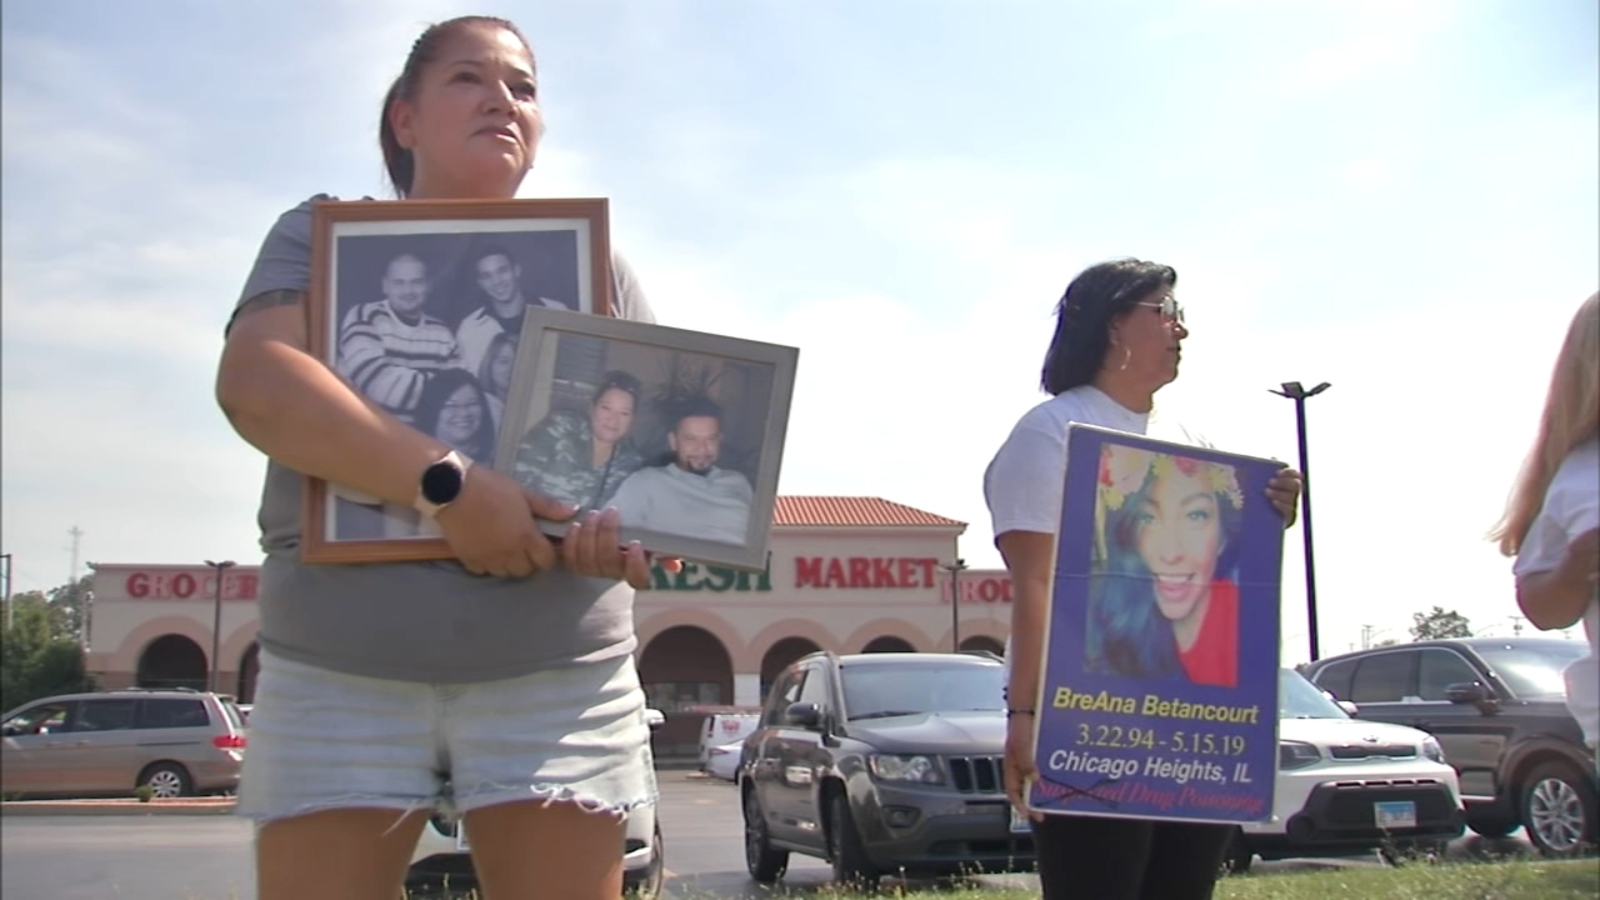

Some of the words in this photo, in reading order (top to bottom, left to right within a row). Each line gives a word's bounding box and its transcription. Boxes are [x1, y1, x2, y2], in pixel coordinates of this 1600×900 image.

[794, 557, 938, 589] MARKET
[1053, 686, 1136, 715] BreAna
[1141, 694, 1260, 724] Betancourt
[1076, 723, 1154, 749] 3.22.94
[1171, 731, 1245, 756] 5.15.19
[1049, 749, 1139, 780] Chicago
[1143, 757, 1227, 785] Heights,
[1233, 763, 1253, 783] IL
